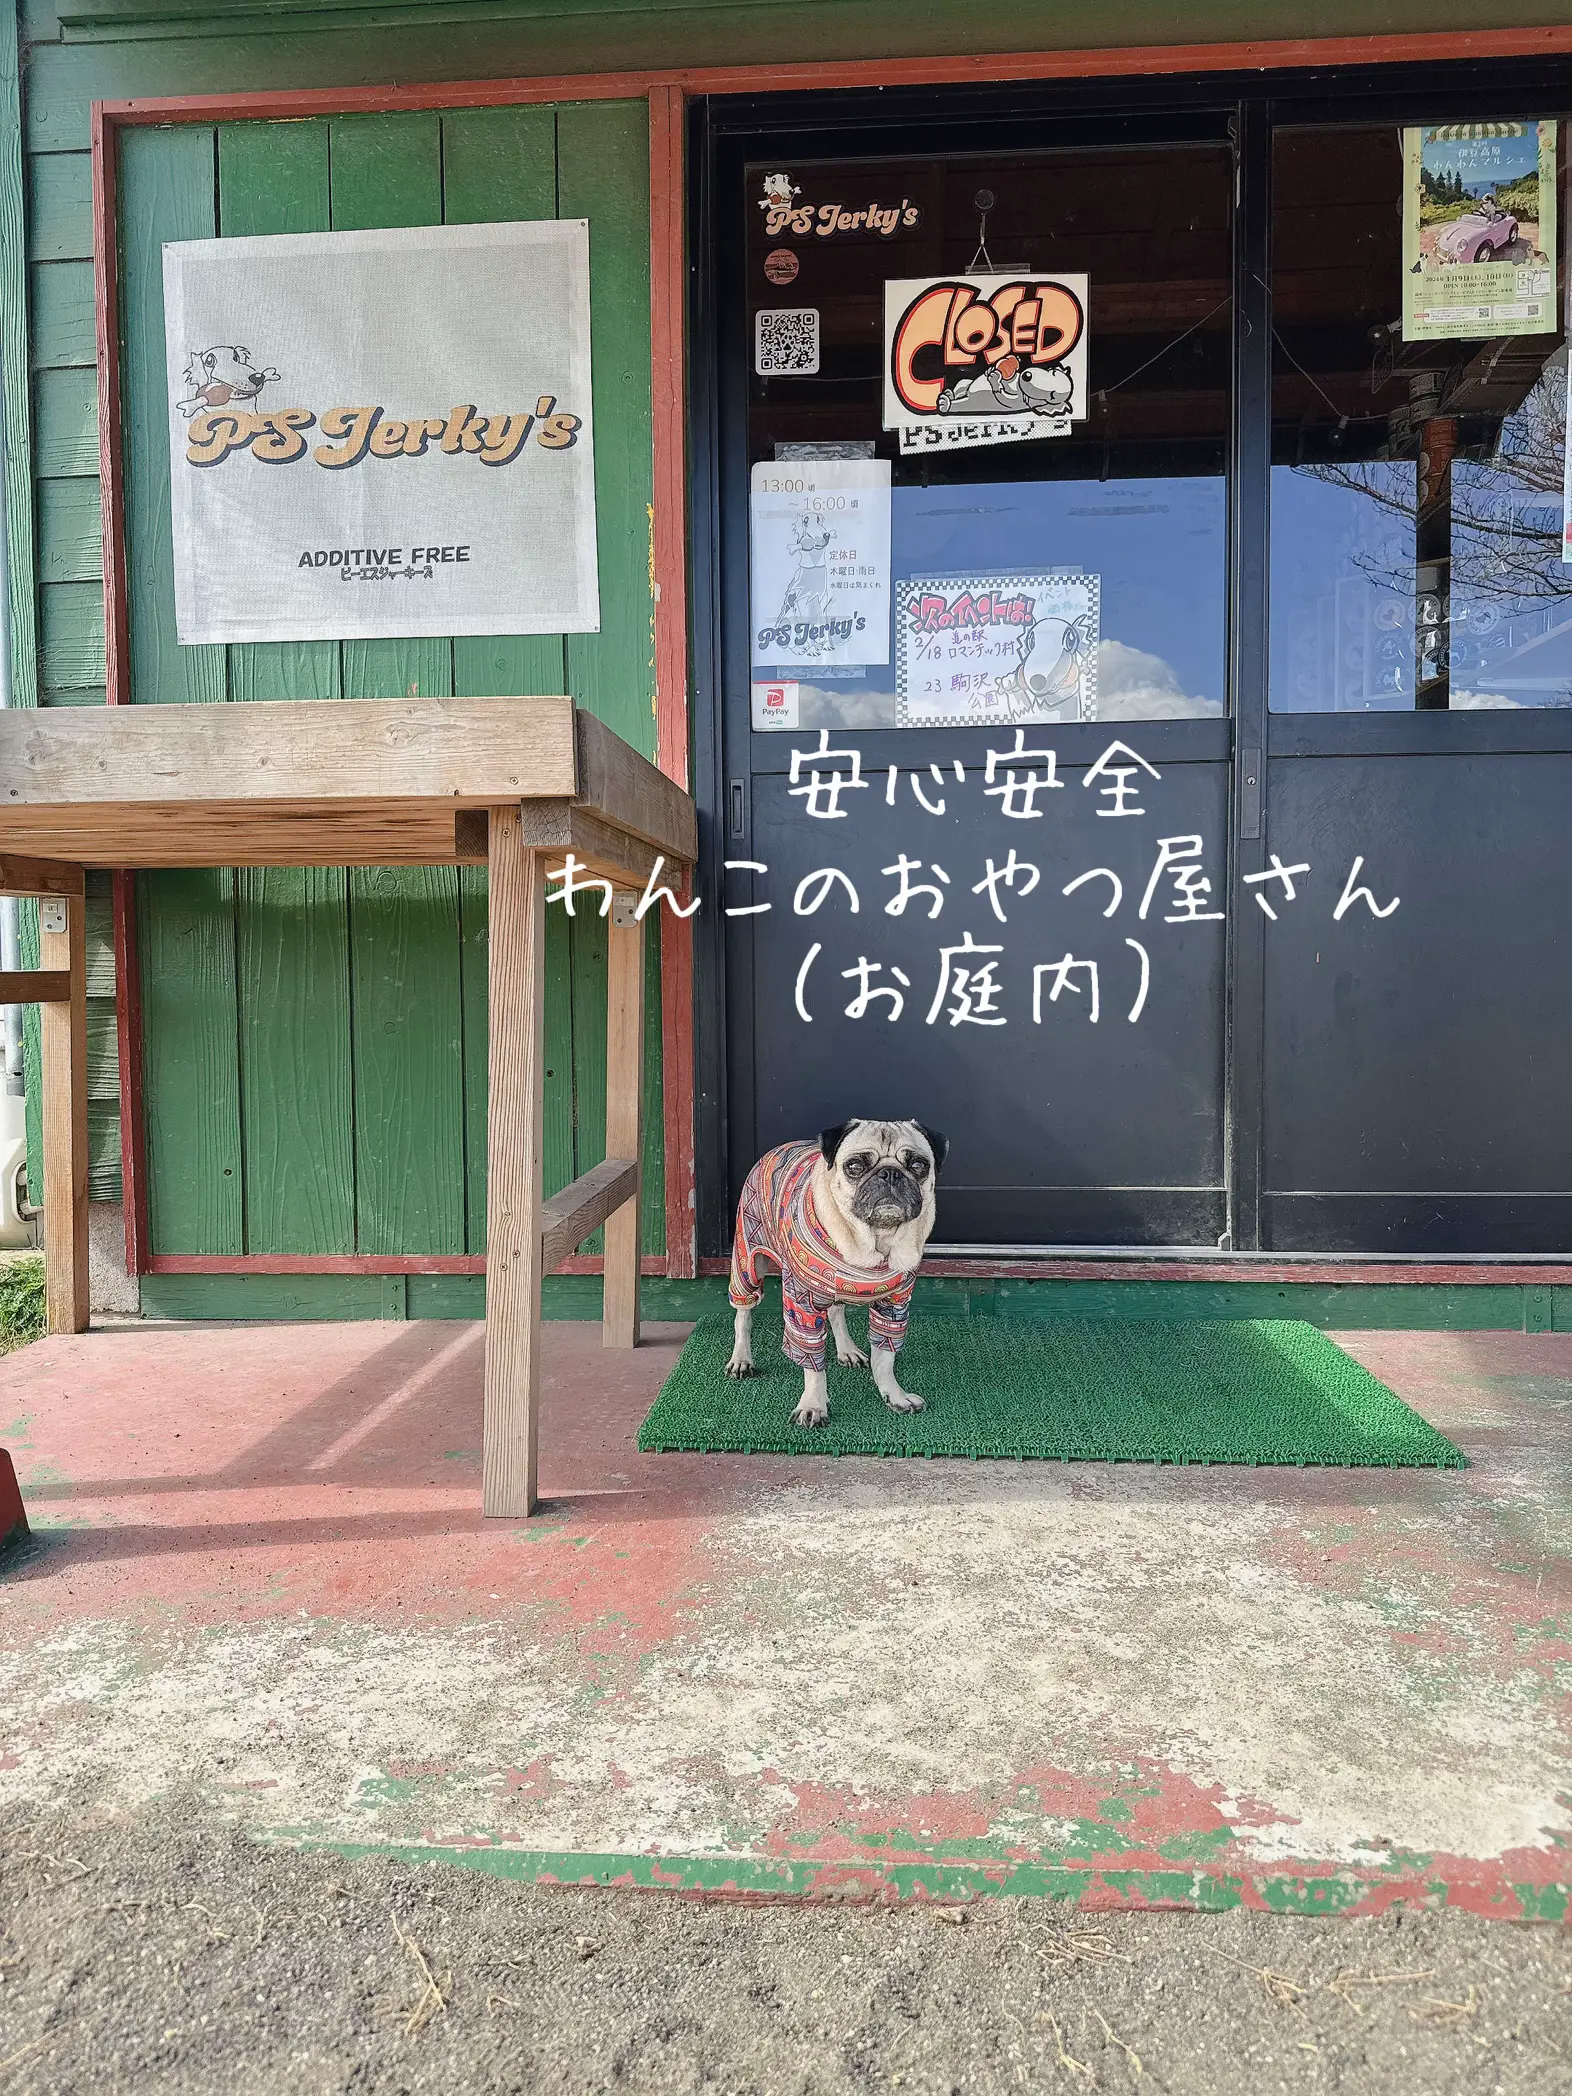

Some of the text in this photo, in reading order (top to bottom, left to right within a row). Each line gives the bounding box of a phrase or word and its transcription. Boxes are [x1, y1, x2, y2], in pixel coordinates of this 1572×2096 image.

[1433, 156, 1526, 170] わんわんマルシェ
[765, 198, 920, 237] PS Jerky's
[892, 281, 1084, 416] CLOSED
[185, 395, 584, 471] PS Jerky's
[761, 479, 804, 493] 13:00
[298, 545, 471, 568] ADDITIVE FREE
[829, 549, 857, 561] 定休日
[829, 581, 882, 589] 水曜日は気まぐれ
[1037, 586, 1071, 603] イベント
[757, 610, 867, 651] PS Jerky's
[951, 629, 988, 645] 道の駅
[914, 635, 1015, 661] 2/18 ロマンチック村
[924, 672, 991, 692] 23 駒沢
[968, 689, 999, 709] 公園
[762, 708, 790, 716] PayPay
